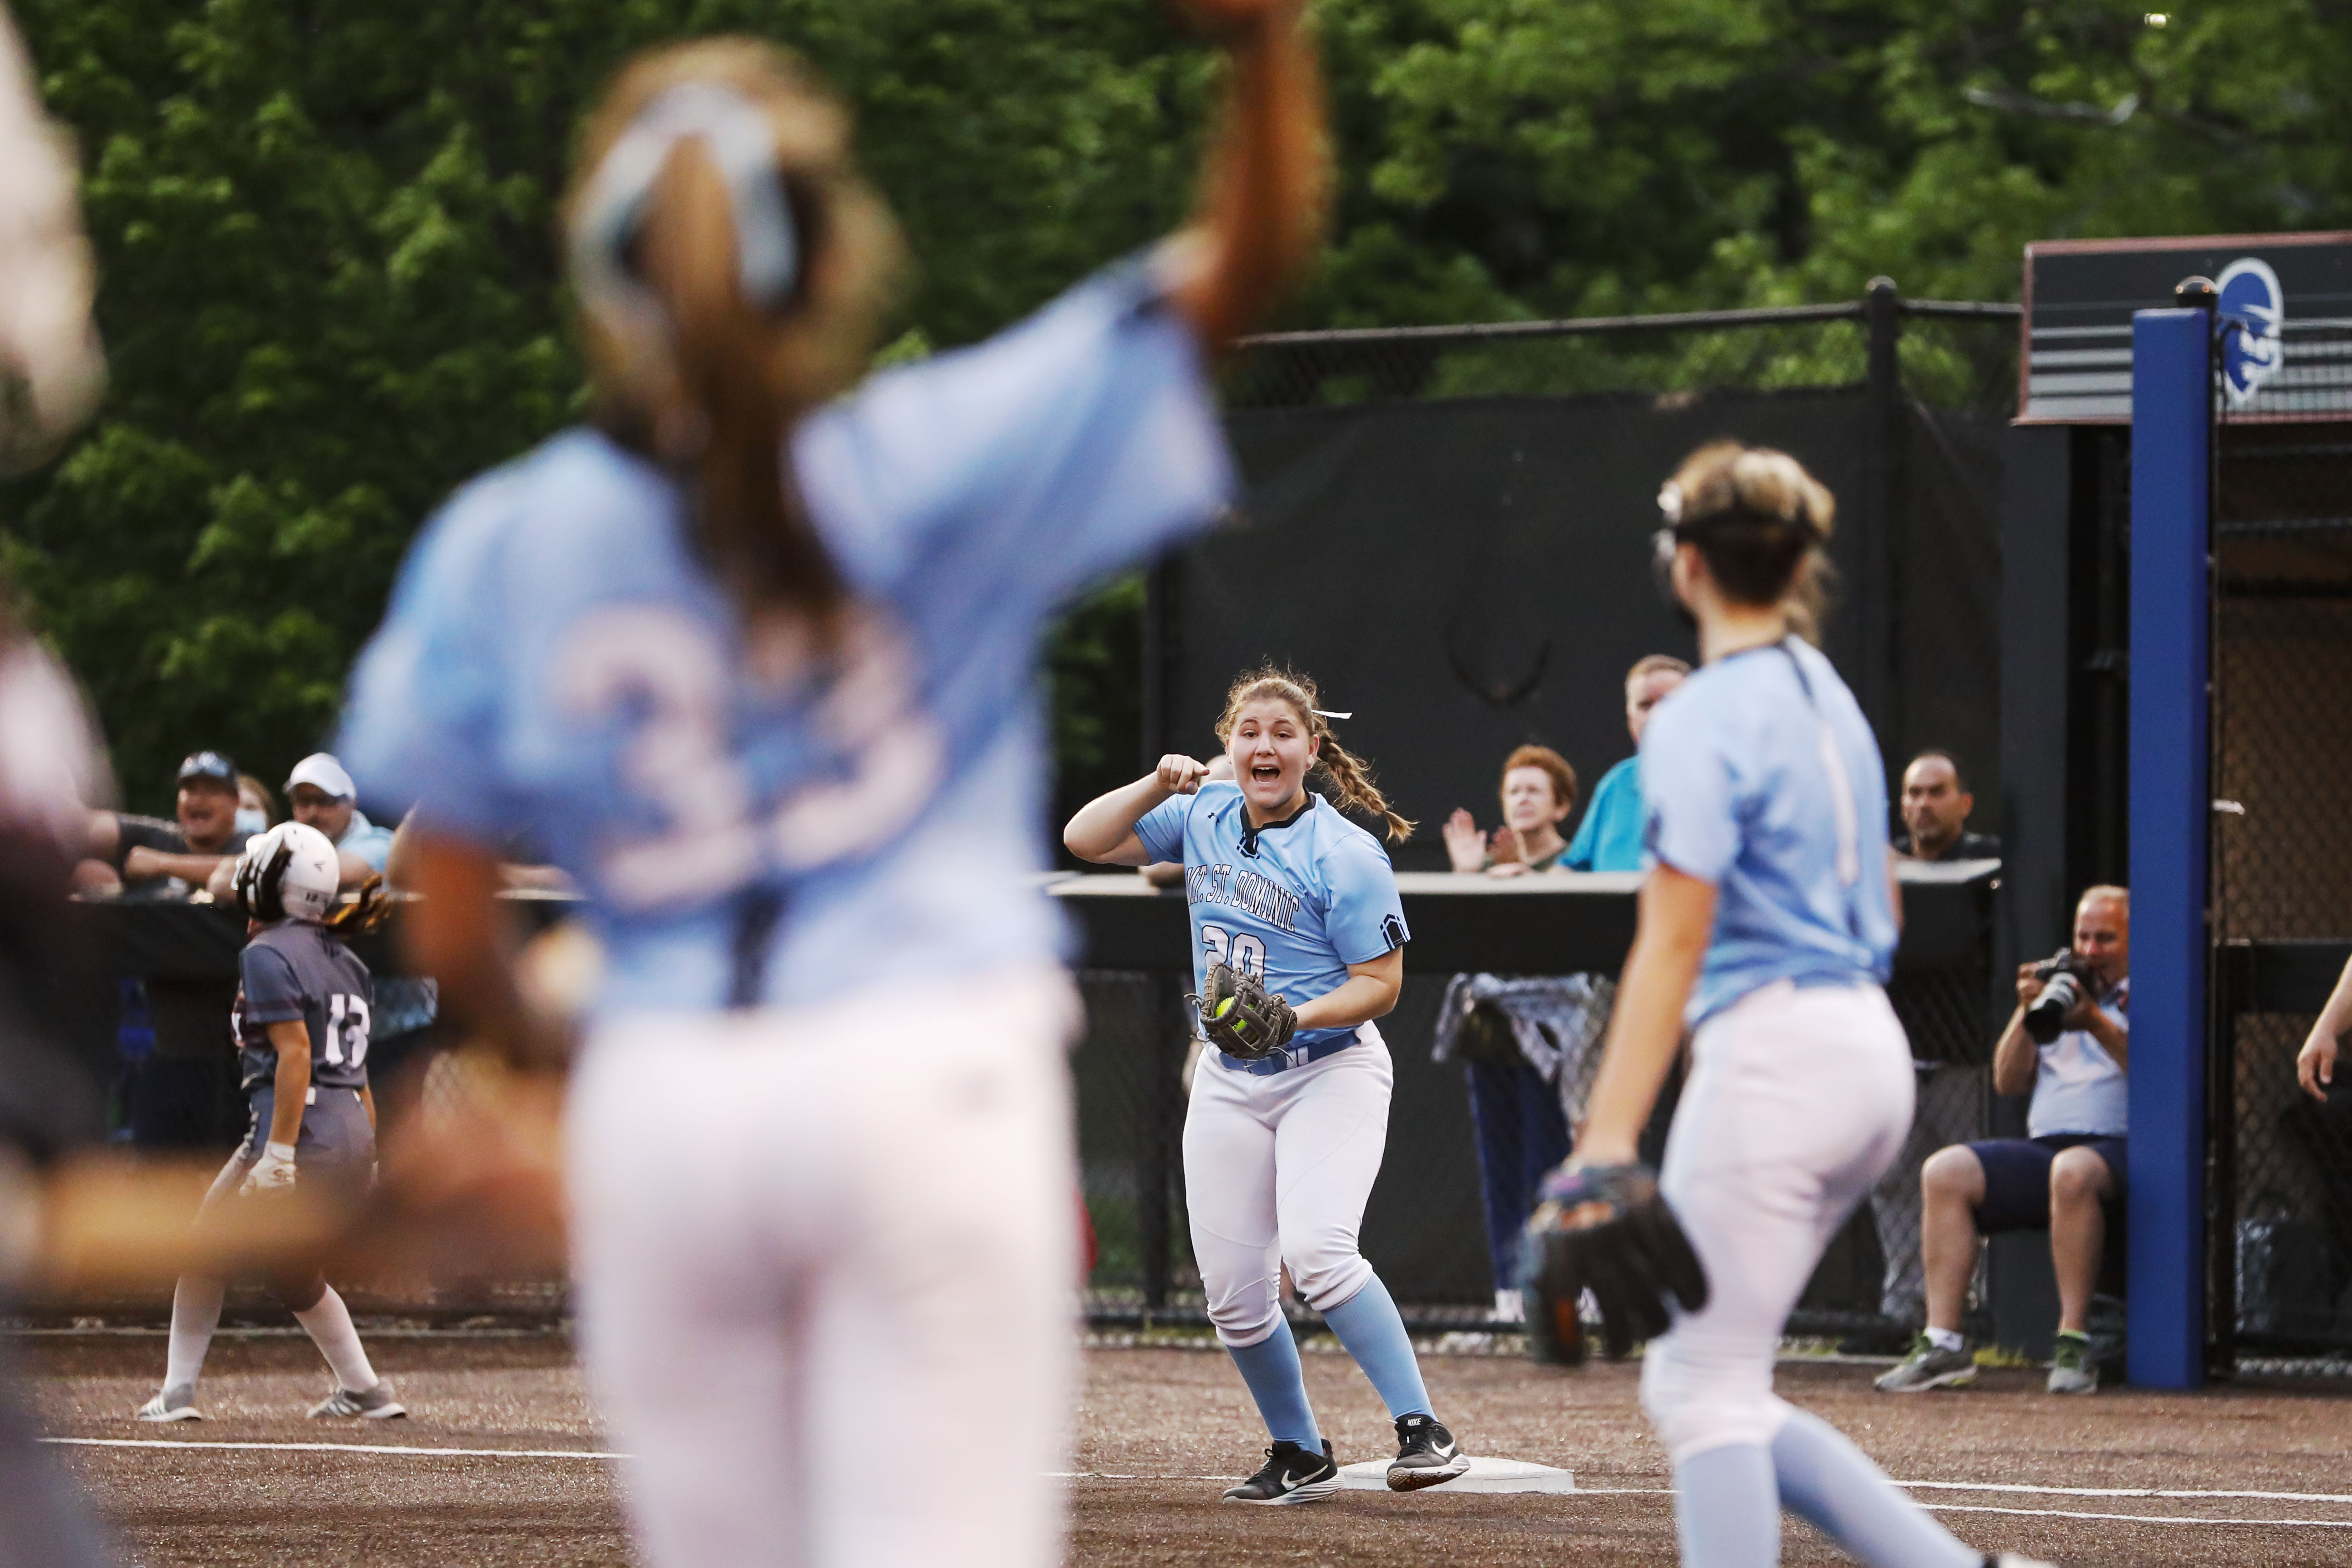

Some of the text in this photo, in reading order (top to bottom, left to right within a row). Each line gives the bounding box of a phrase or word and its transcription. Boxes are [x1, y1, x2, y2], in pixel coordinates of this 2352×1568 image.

[1206, 864, 1232, 904] ST.
[1231, 870, 1300, 932] DOMINIC
[1202, 925, 1266, 979] 20
[325, 993, 371, 1068] 13
[1407, 1418, 1422, 1427] NIKE
